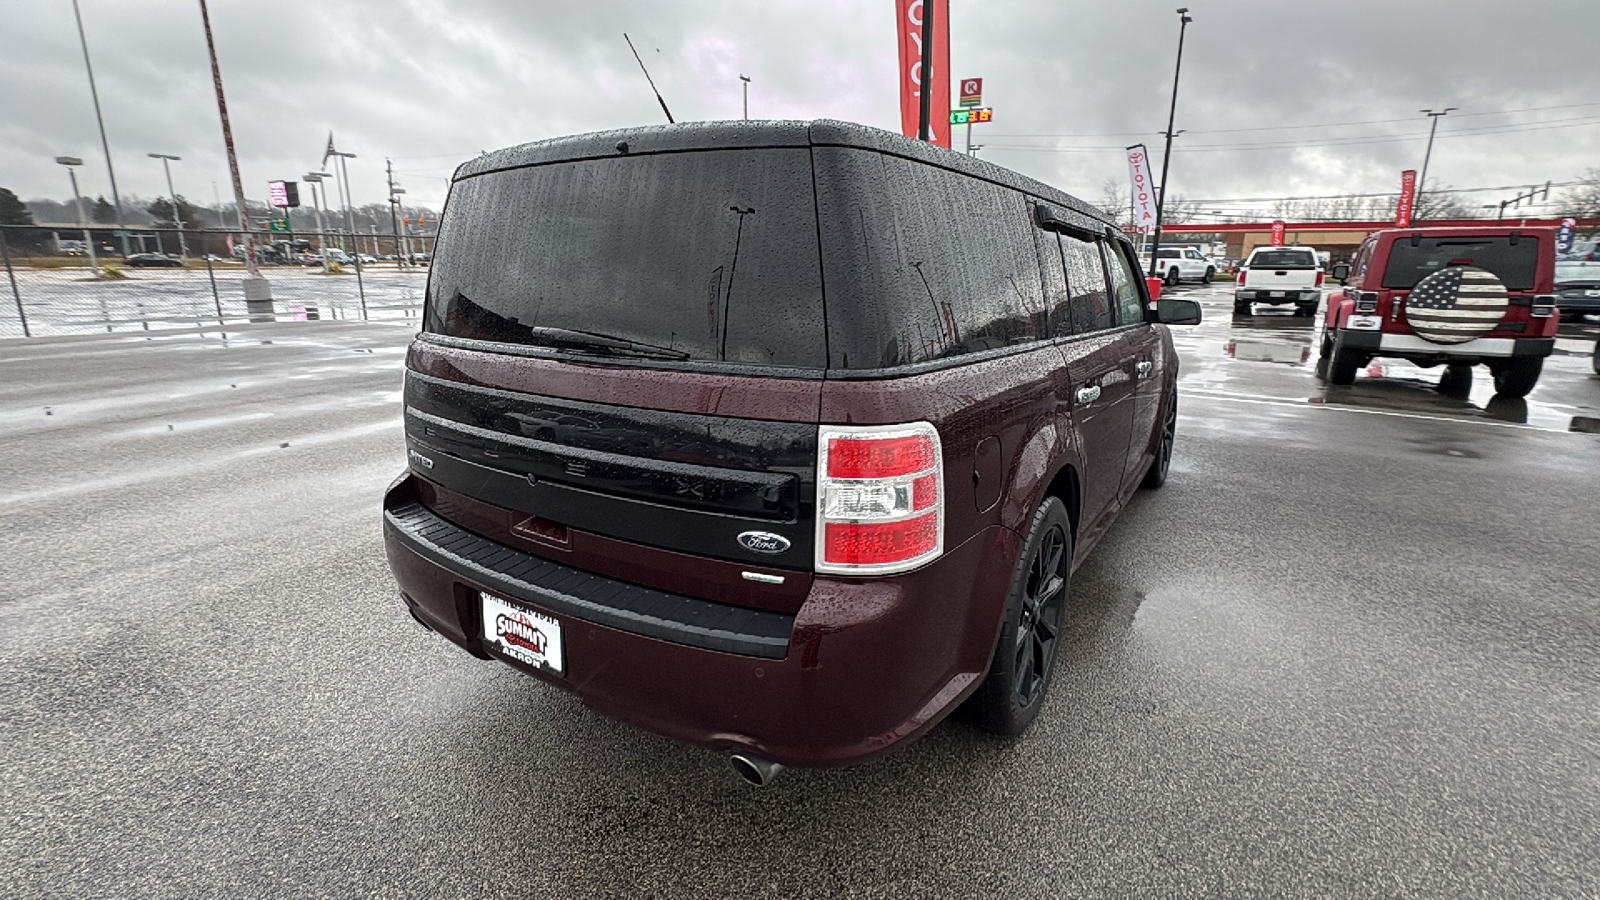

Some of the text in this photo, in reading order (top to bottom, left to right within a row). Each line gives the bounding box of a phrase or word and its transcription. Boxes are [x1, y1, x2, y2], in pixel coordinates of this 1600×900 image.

[967, 82, 978, 94] K
[1133, 164, 1152, 221] TOYOTA
[747, 534, 778, 550] Ford
[496, 614, 547, 655] SUMMIT
[516, 637, 540, 654] TOYOTA
[502, 646, 541, 669] AKRON
